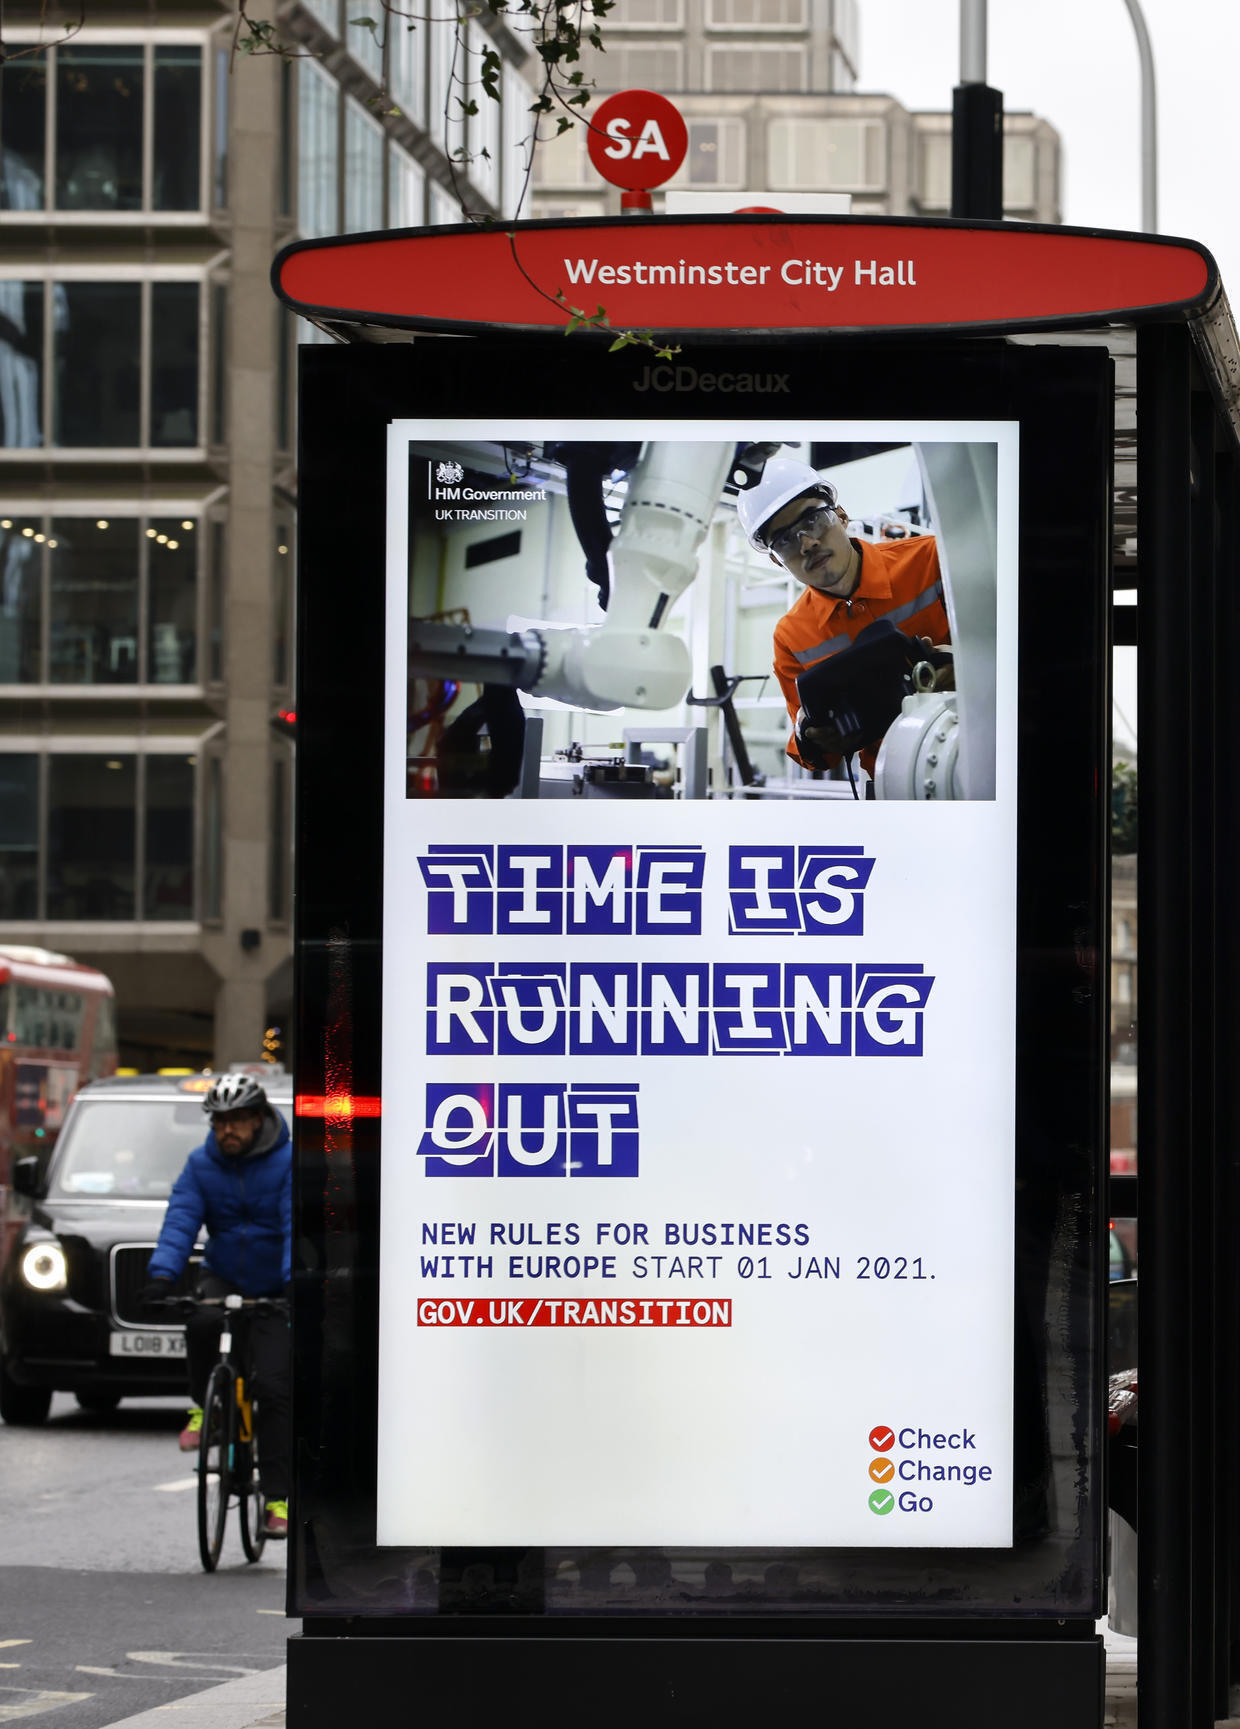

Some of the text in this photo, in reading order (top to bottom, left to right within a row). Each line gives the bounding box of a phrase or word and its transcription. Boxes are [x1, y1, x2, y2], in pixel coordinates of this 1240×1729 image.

[605, 119, 669, 160] SA
[564, 259, 916, 291] Westminster City Hall
[633, 366, 790, 393] JCDecaux
[435, 487, 547, 501] HM Government
[435, 509, 528, 521] UK TRANSITION
[424, 853, 862, 926] TIME IS
[432, 971, 924, 1047] RUNNING
[427, 1092, 633, 1168] OUT
[422, 1222, 810, 1246] NEW RULES FOR BUSINESS
[420, 1255, 936, 1280] WITH EUROPE START 01 JAN 2021.
[419, 1300, 730, 1325] GOV.UK/TRANSITION
[898, 1427, 976, 1450] Check
[898, 1459, 993, 1486] Change
[898, 1491, 933, 1513] Go
